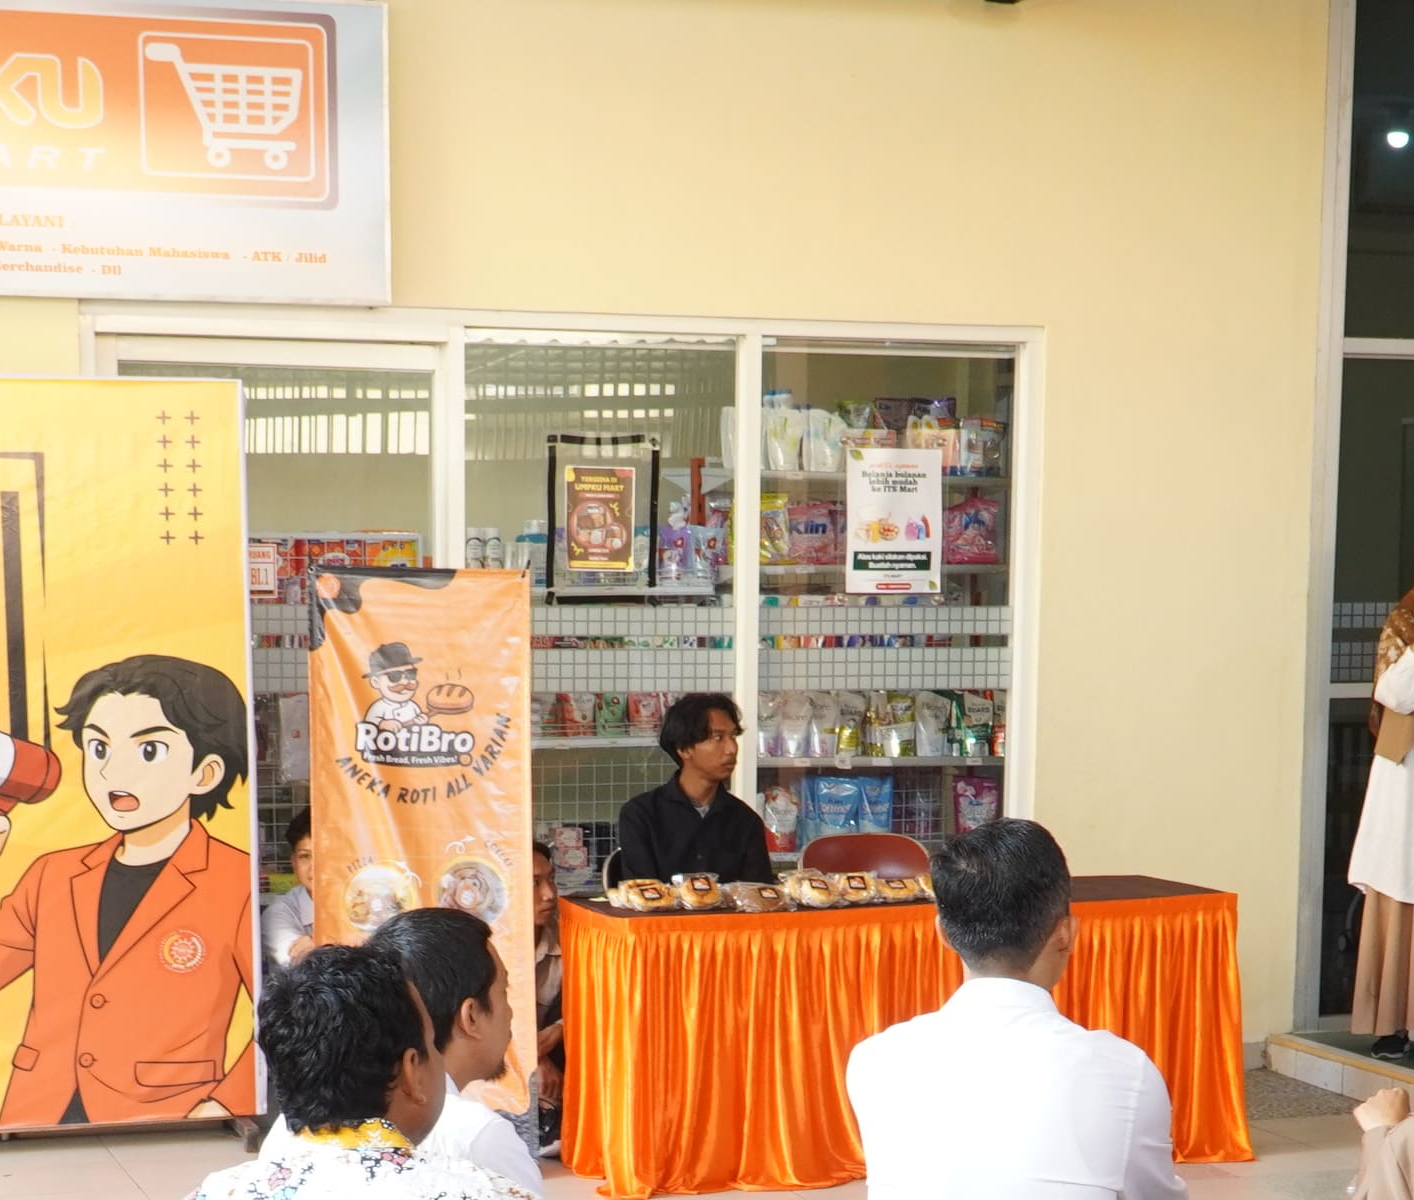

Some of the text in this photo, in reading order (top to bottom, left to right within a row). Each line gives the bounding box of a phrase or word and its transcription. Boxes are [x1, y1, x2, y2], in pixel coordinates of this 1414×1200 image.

[61, 243, 144, 257] Kebutuhan
[148, 246, 230, 260] Mahasiswa
[251, 251, 282, 263] ATK
[295, 251, 327, 265] Jilid
[101, 264, 122, 276] Dll
[356, 722, 476, 753] RotiBro
[335, 712, 512, 805] ANEKA ROTI ALL VARIAN
